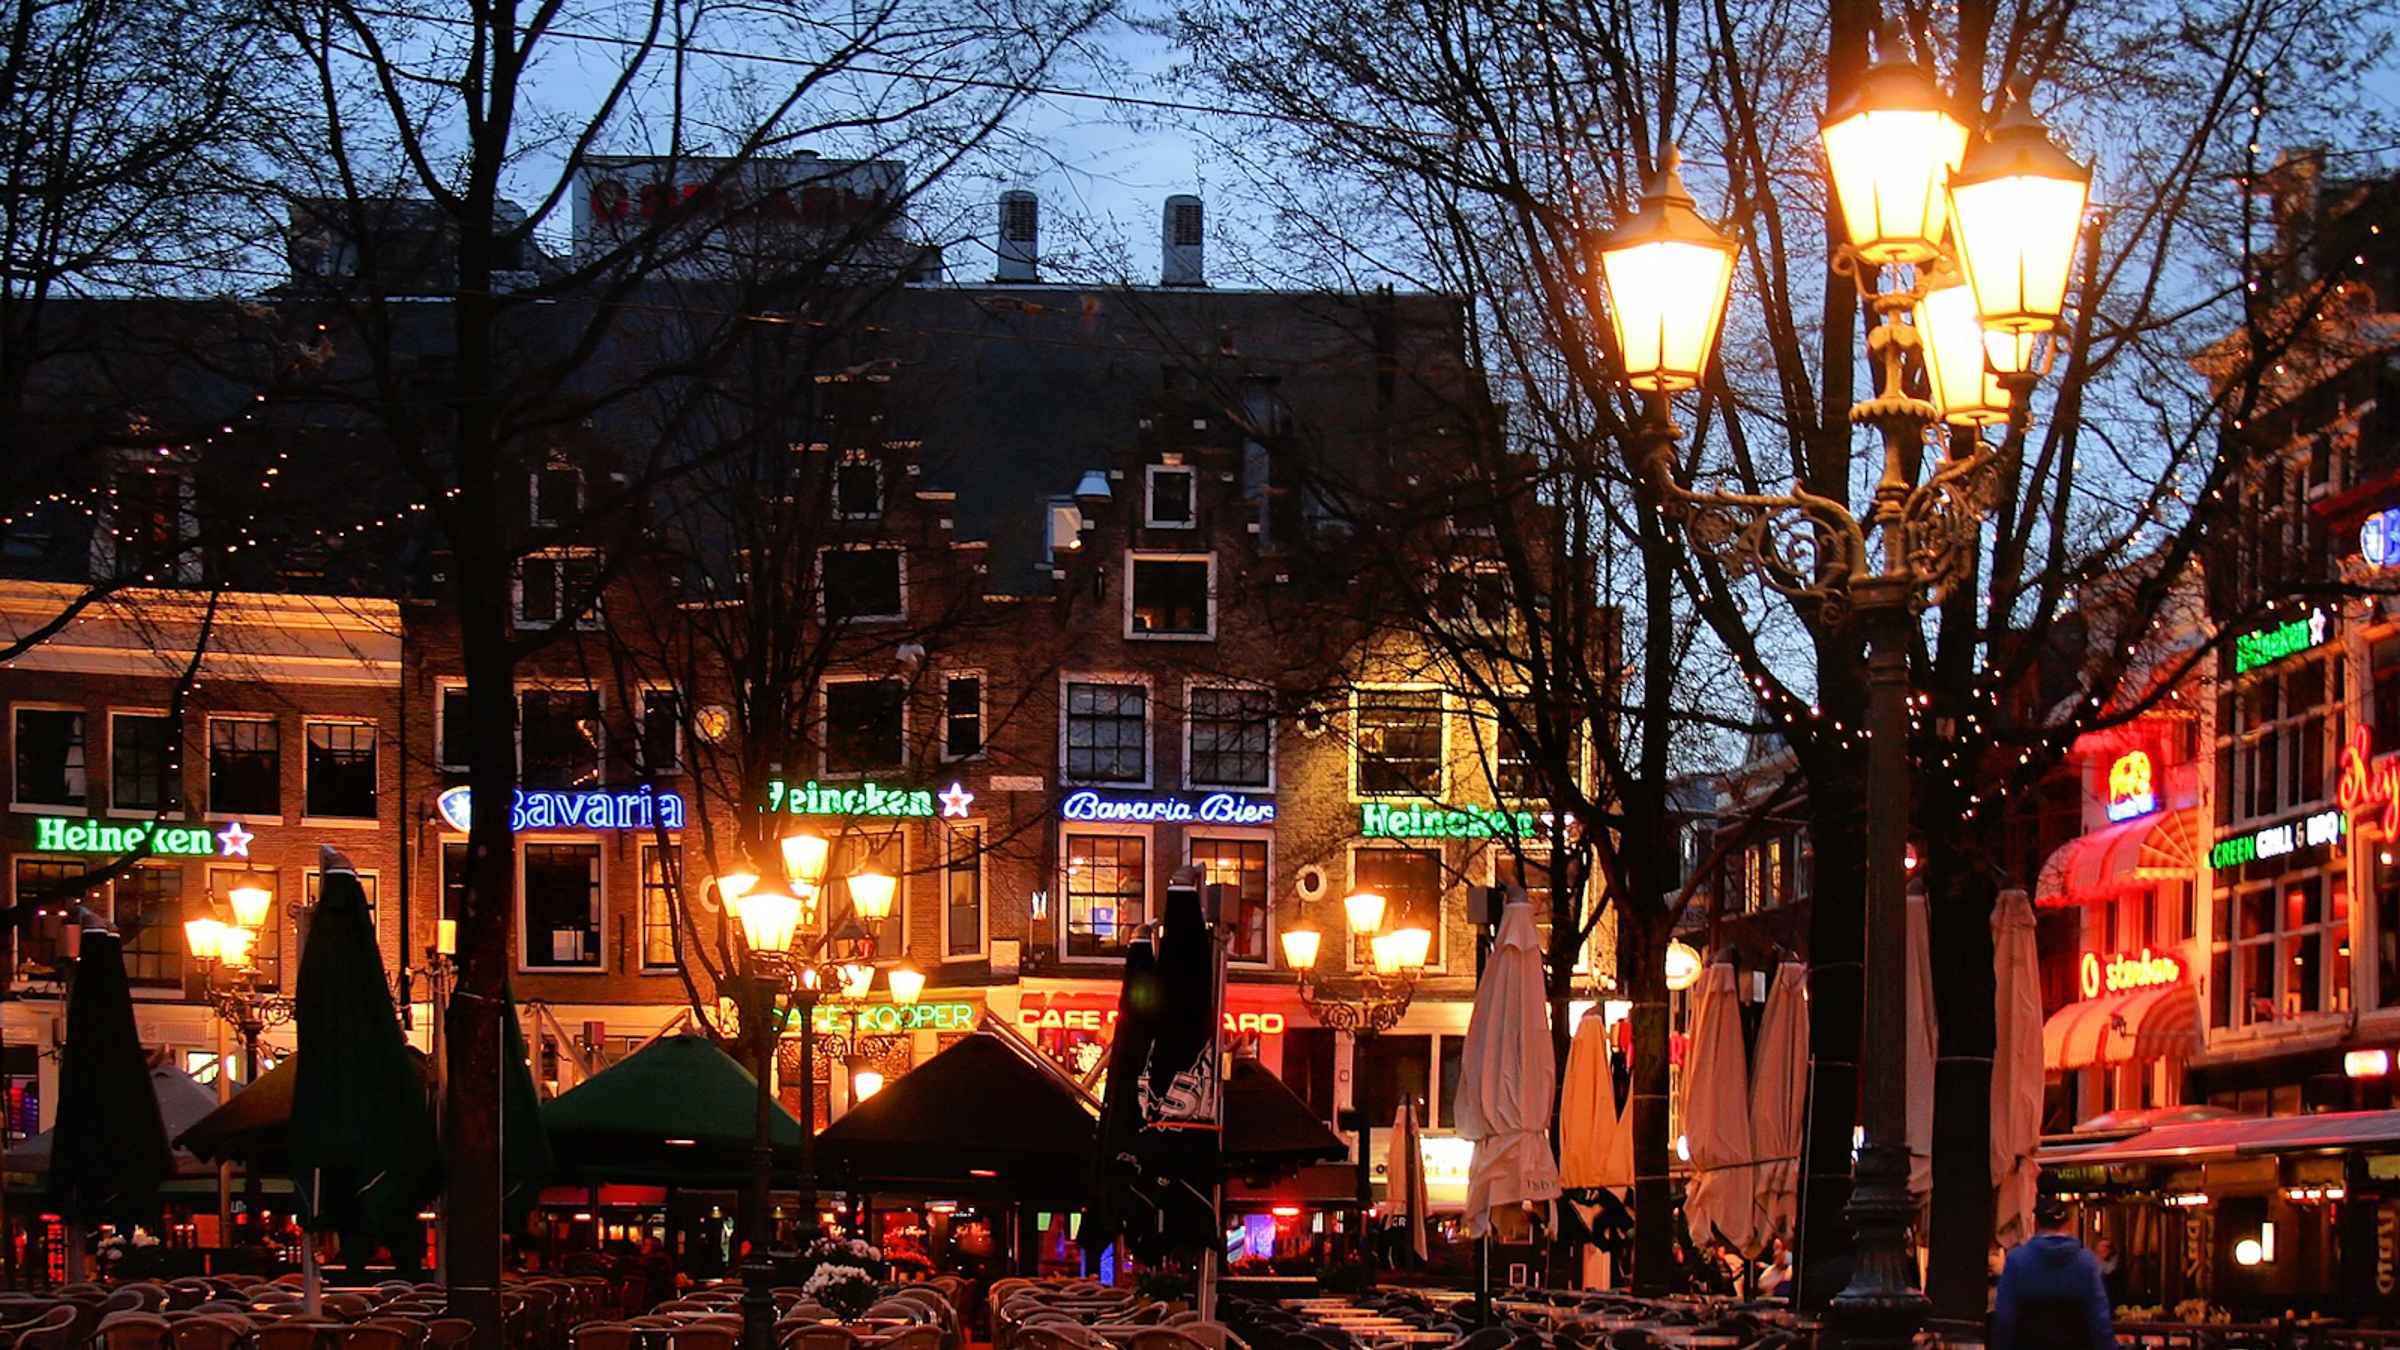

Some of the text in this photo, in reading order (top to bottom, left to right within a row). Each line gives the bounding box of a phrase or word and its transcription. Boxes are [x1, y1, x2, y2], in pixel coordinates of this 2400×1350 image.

[1062, 790, 1273, 823] Bavaria Bier
[2212, 835, 2255, 869] GREEN
[857, 1004, 974, 1031] KOOPER
[1018, 1008, 1101, 1031] CAFE
